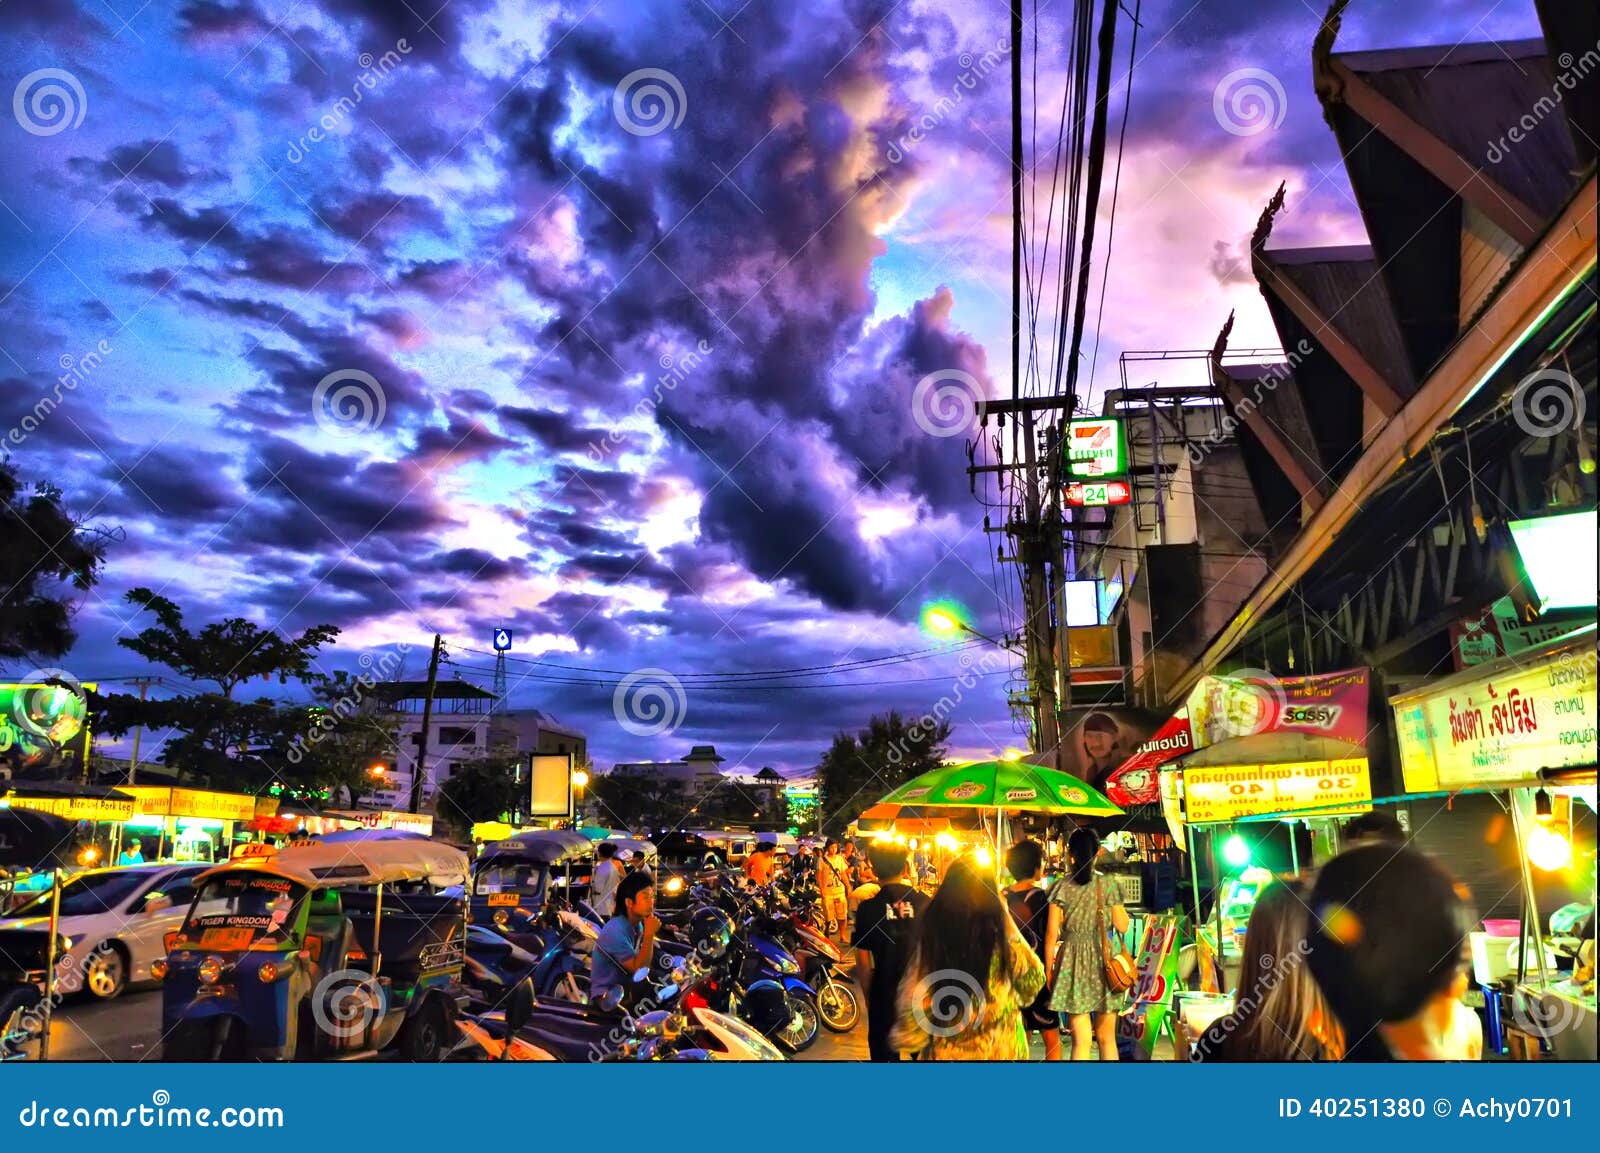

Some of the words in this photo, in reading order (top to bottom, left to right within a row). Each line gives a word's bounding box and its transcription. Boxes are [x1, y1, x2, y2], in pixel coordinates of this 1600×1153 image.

[1085, 488, 1106, 501] 24
[1559, 722, 1597, 748] คอหมูย่า
[201, 917, 225, 926] TIGER
[226, 916, 270, 925] KINGDOM
